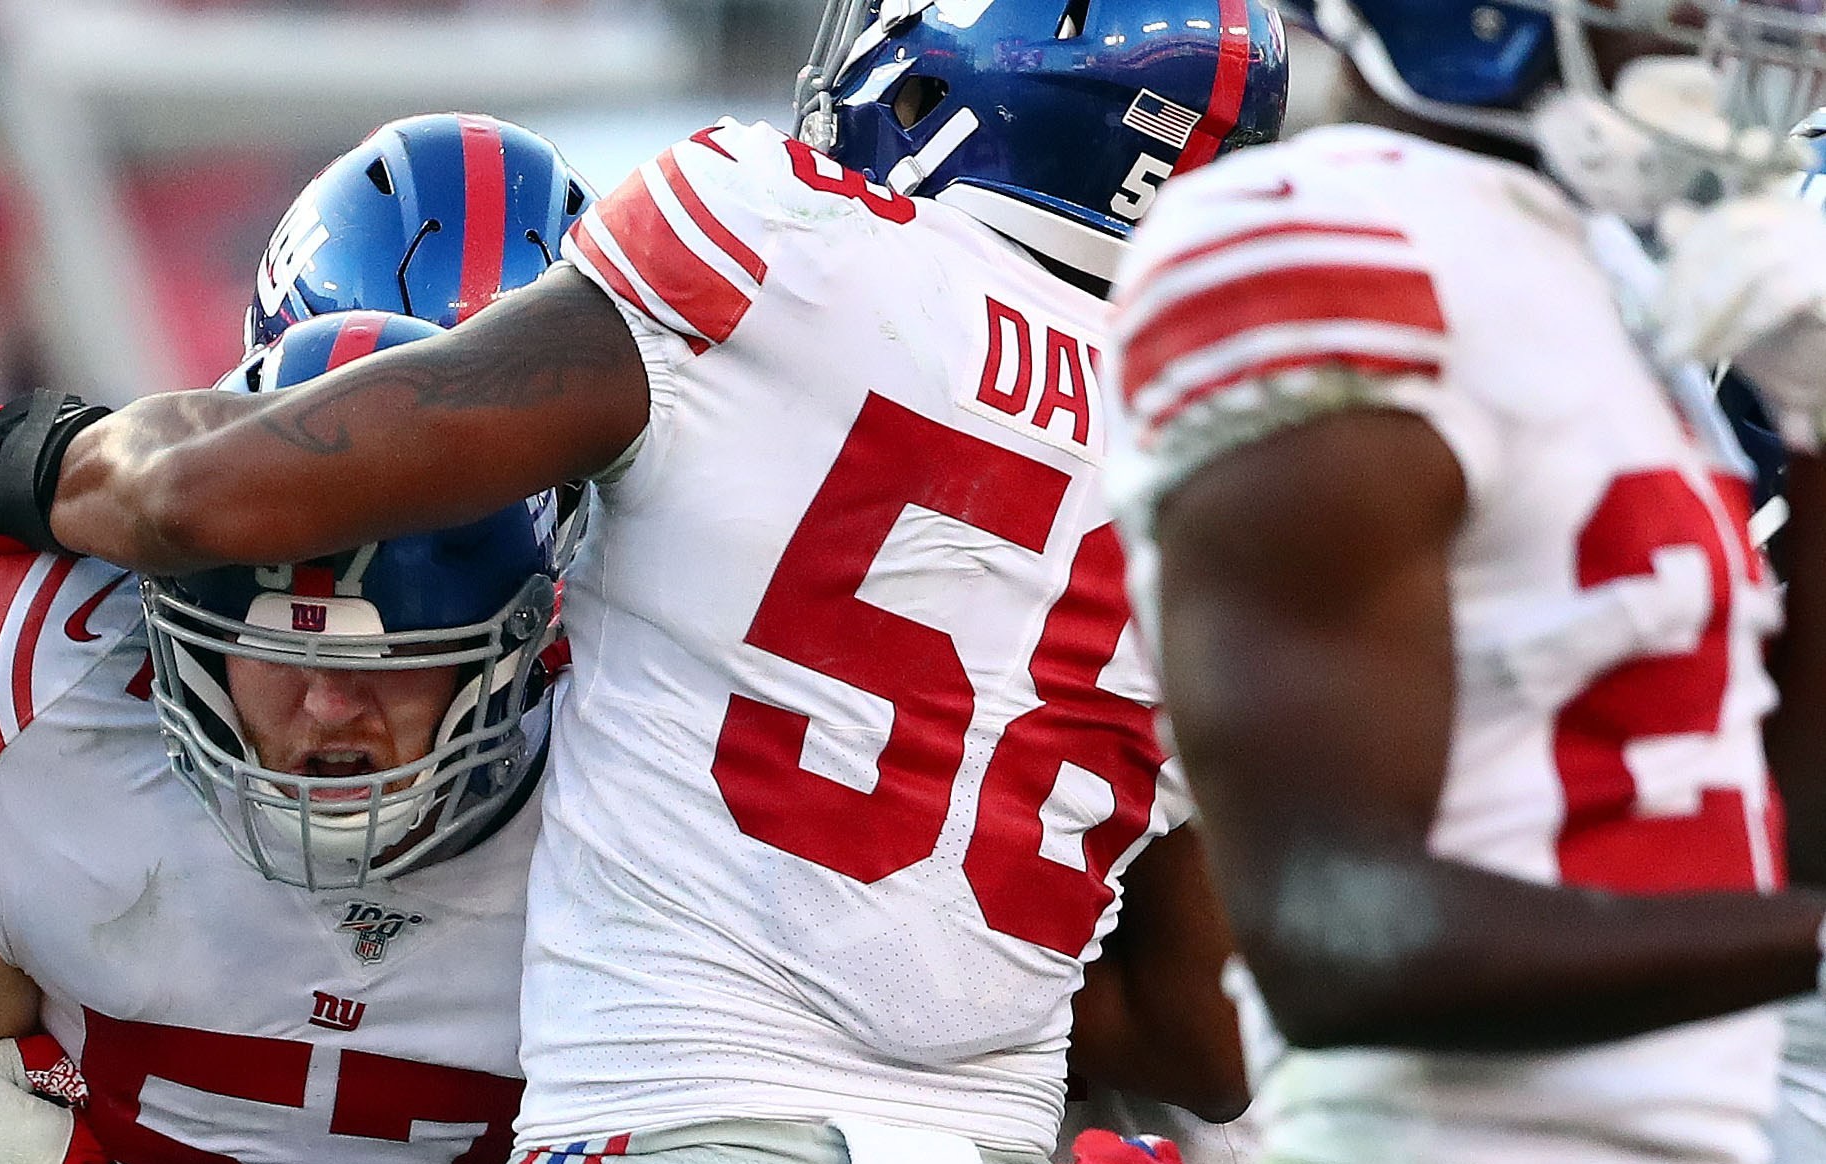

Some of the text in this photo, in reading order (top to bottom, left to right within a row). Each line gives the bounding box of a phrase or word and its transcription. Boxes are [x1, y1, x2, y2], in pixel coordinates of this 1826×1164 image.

[976, 295, 1103, 446] DA
[711, 389, 1166, 960] 58
[1554, 467, 1787, 895] 2
[309, 990, 367, 1032] ny
